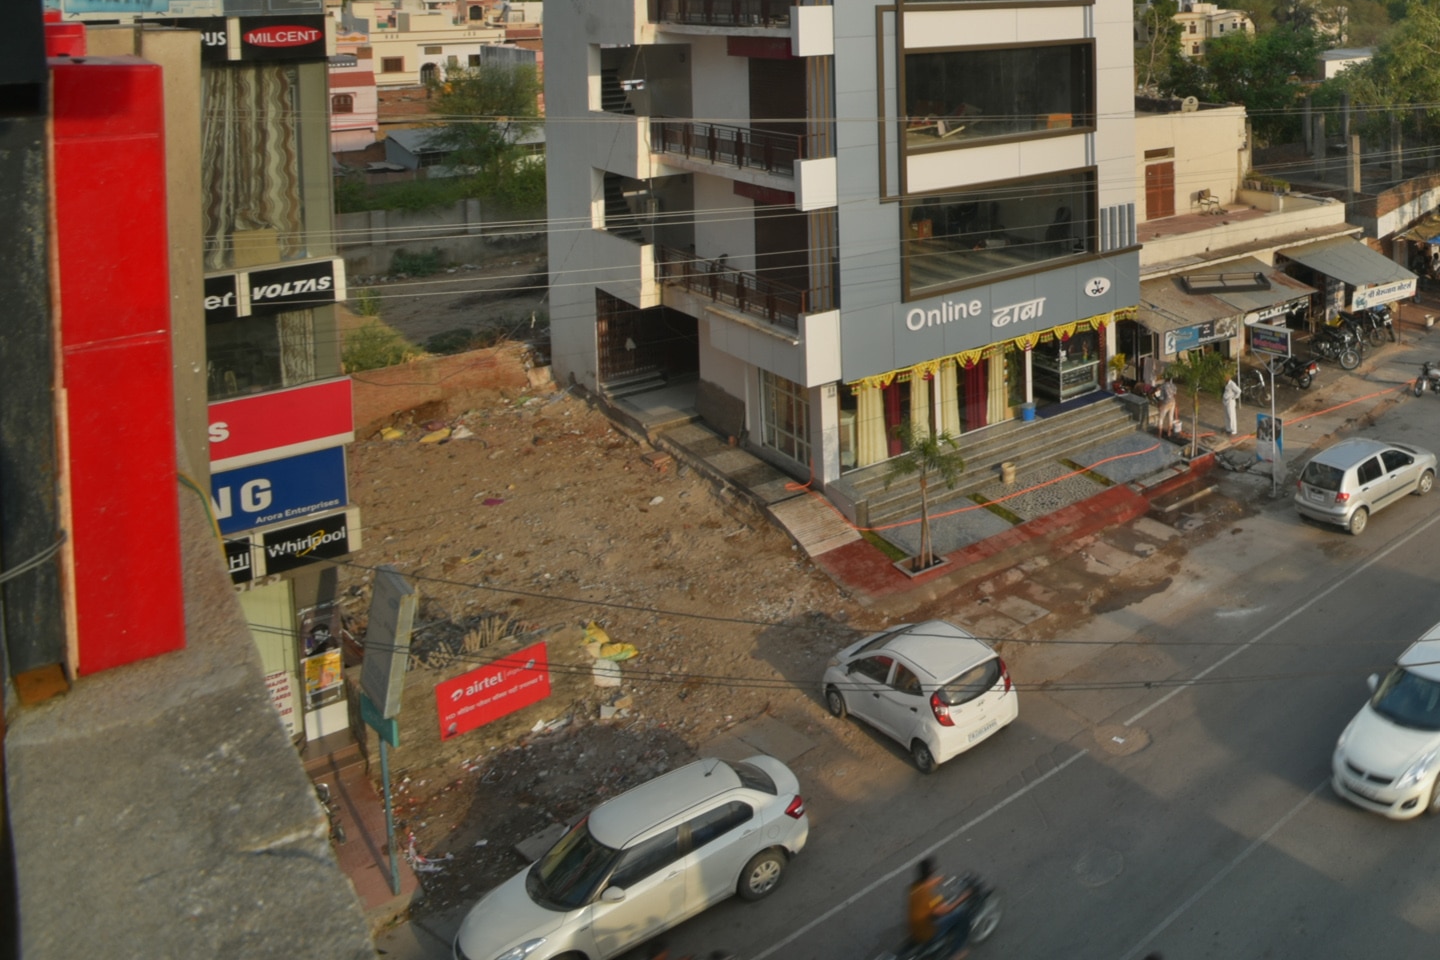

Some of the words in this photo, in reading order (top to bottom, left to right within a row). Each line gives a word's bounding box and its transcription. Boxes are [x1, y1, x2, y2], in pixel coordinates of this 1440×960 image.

[249, 29, 319, 46] MILCENT
[253, 276, 332, 300] VOLTAS
[204, 291, 233, 310] er
[906, 299, 982, 331] Online
[992, 296, 1047, 328] ढाबा
[255, 512, 283, 524] Arora
[285, 498, 340, 517] Enterprises
[268, 526, 346, 558] Whirlpool
[466, 672, 503, 696] airtel
